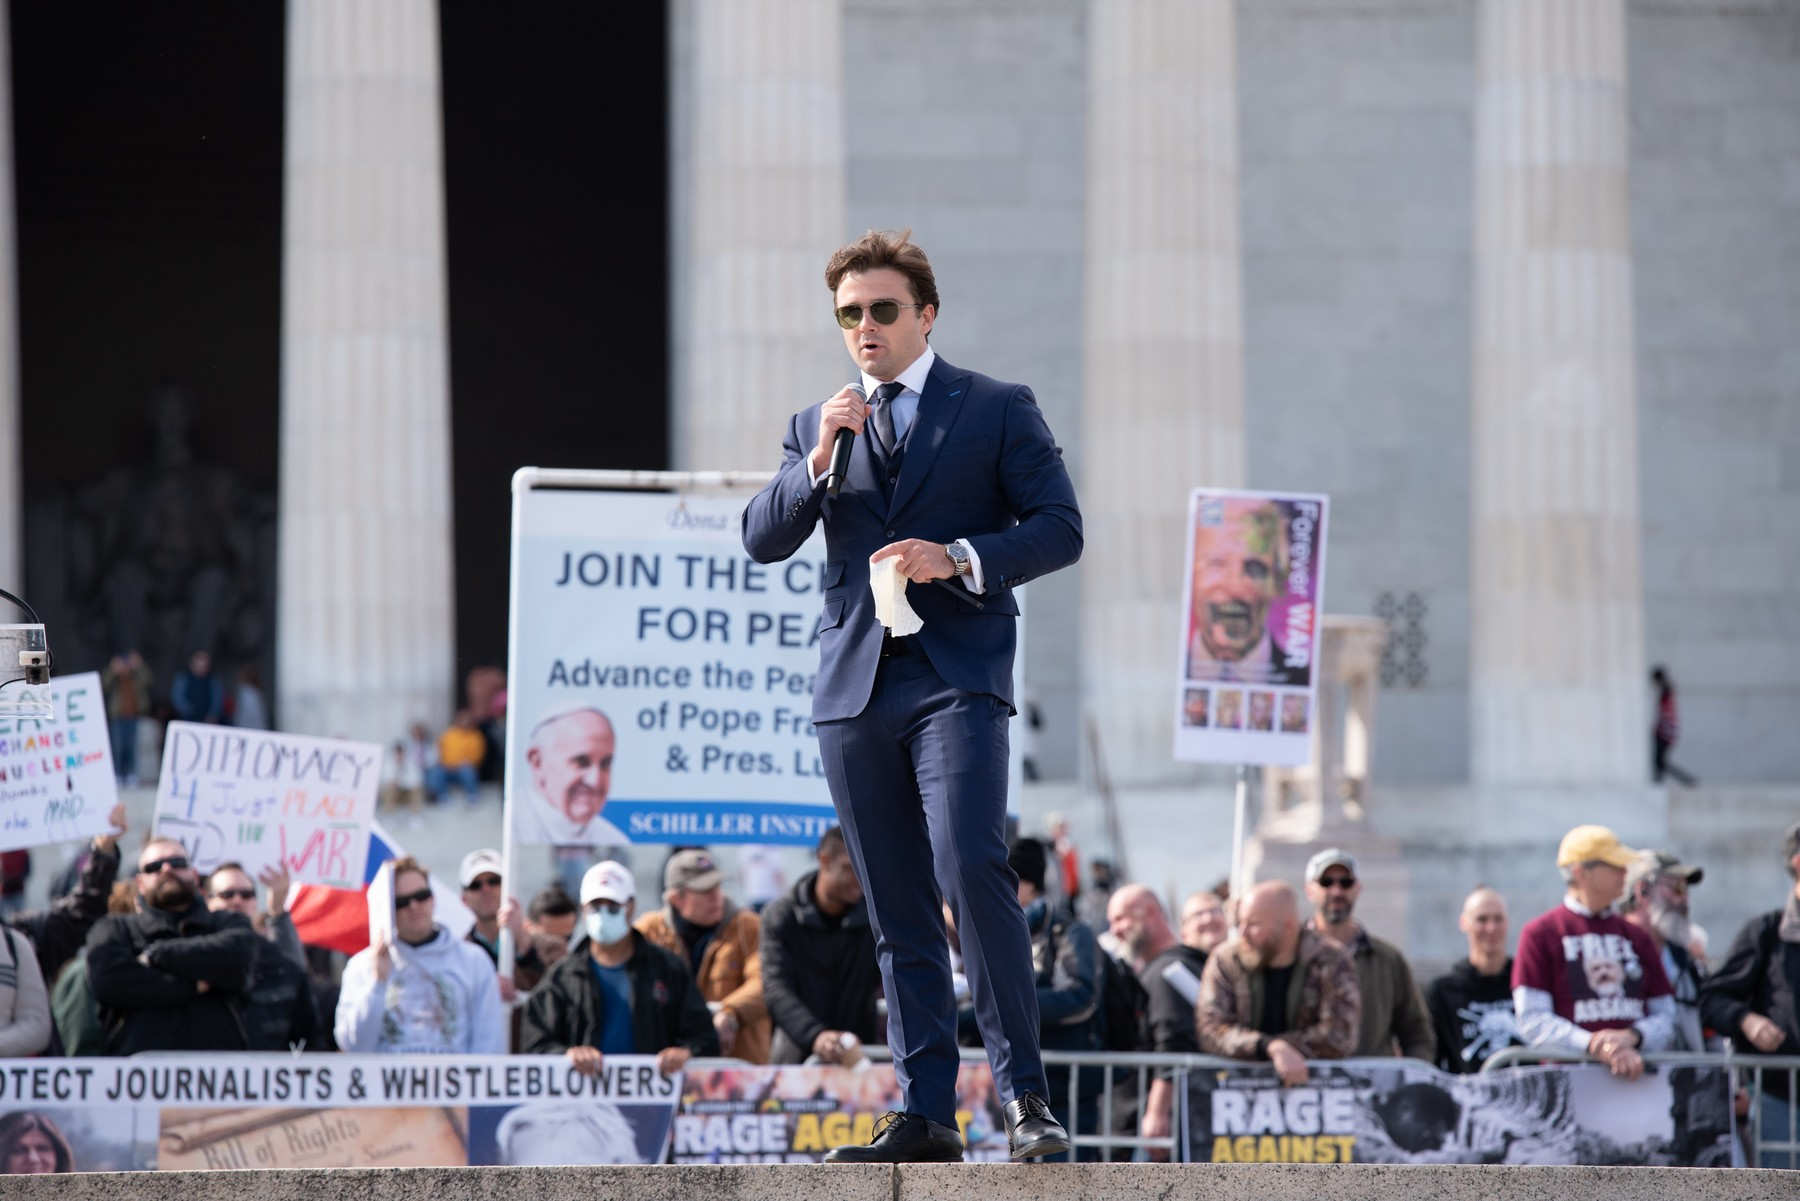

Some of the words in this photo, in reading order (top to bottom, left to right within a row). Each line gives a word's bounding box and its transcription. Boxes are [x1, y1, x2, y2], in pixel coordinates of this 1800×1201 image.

[555, 552, 661, 588] JOIN
[676, 554, 768, 592] THE
[637, 607, 730, 643] FOR
[1283, 601, 1313, 669] WAR
[547, 659, 691, 689] Advance
[703, 661, 754, 691] the
[637, 701, 669, 731] of
[679, 703, 762, 739] Pope
[170, 729, 374, 790] DIPLOMACY
[665, 744, 690, 772] &
[701, 746, 782, 774] Pres.
[629, 812, 757, 836] SCHILLER
[279, 823, 353, 879] WAR
[106, 1066, 334, 1100] JOURNALISTS
[348, 1066, 367, 1100] &
[381, 1064, 676, 1099] WHISTLEBLOWERS
[1211, 1089, 1355, 1135] RAGE
[203, 1135, 249, 1169] Bill
[256, 1138, 279, 1166] of
[282, 1111, 362, 1153] Rights
[673, 1114, 788, 1152] RAGE
[1210, 1135, 1357, 1164] AGAINST
